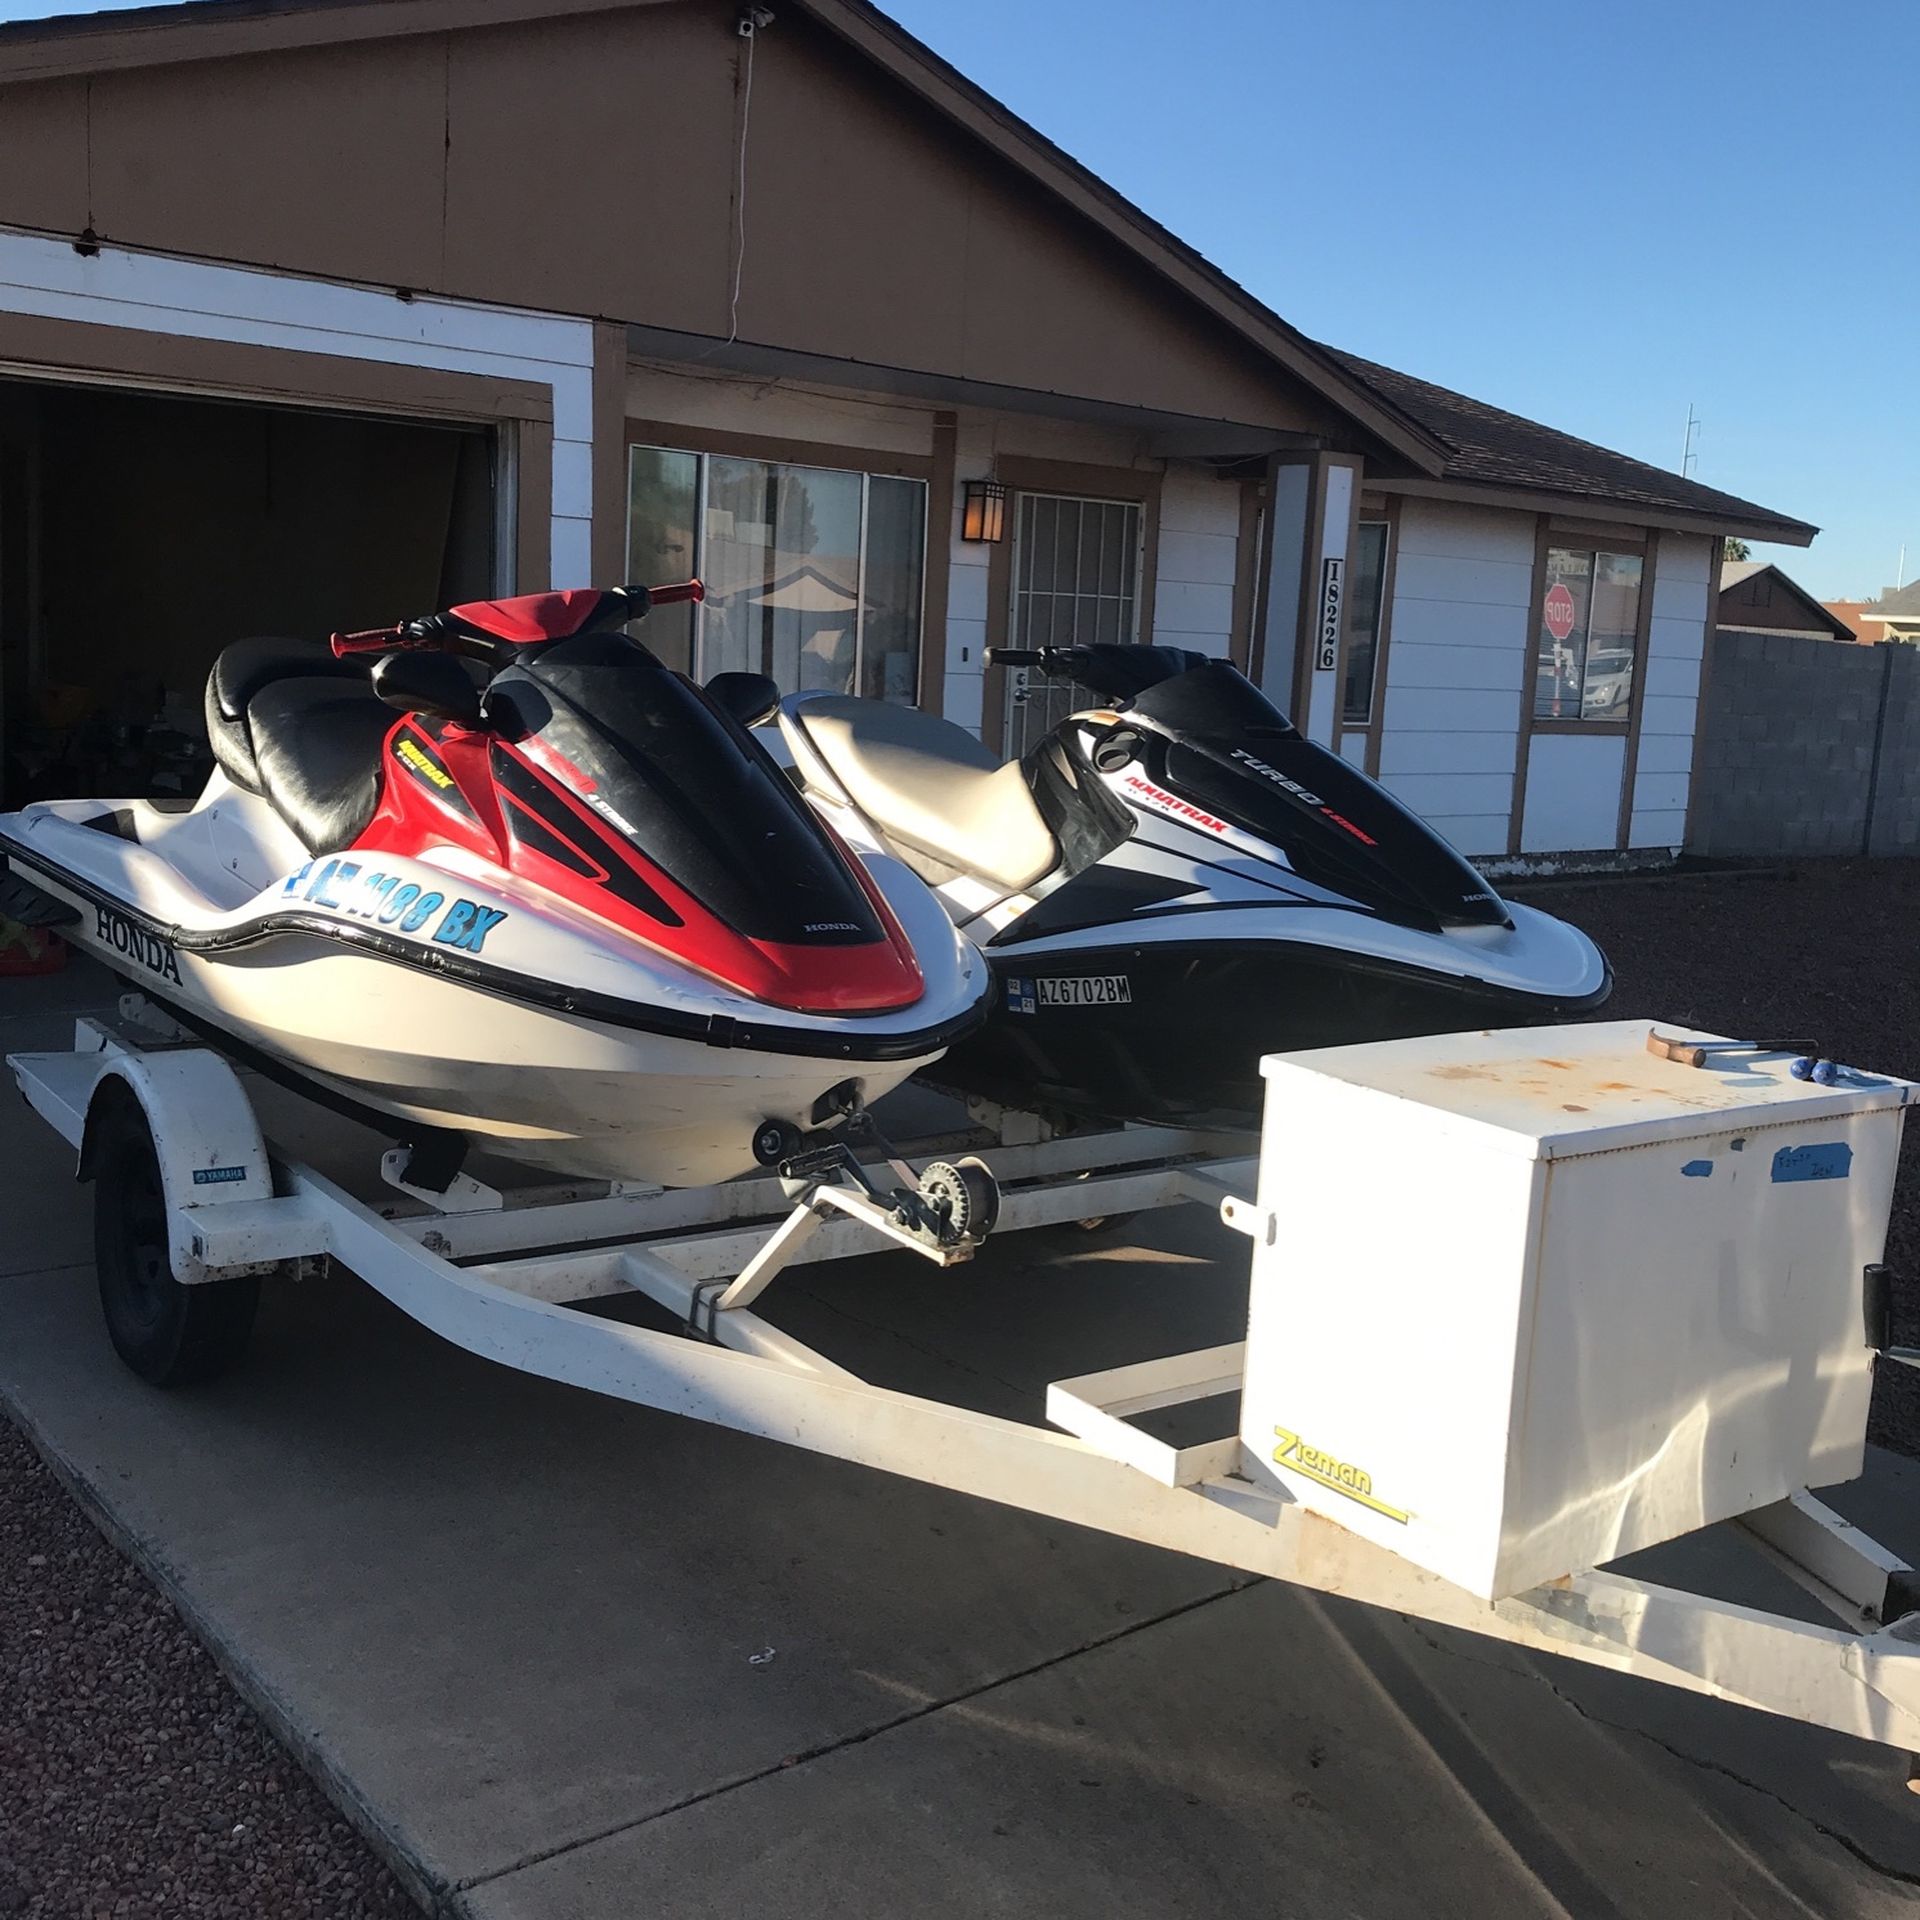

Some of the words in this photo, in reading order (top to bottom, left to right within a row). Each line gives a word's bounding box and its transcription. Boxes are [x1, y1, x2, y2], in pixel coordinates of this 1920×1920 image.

[1322, 562, 1339, 667] 18226
[1124, 776, 1229, 834] AQUATRAX
[1230, 749, 1325, 807] TURBO
[97, 908, 184, 987] HONDA
[432, 898, 509, 954] BX
[803, 923, 862, 932] HONDA
[1040, 978, 1131, 1004] AZ6702BM
[206, 1169, 244, 1180] YAMAHA
[1273, 1425, 1385, 1505] Zieman
